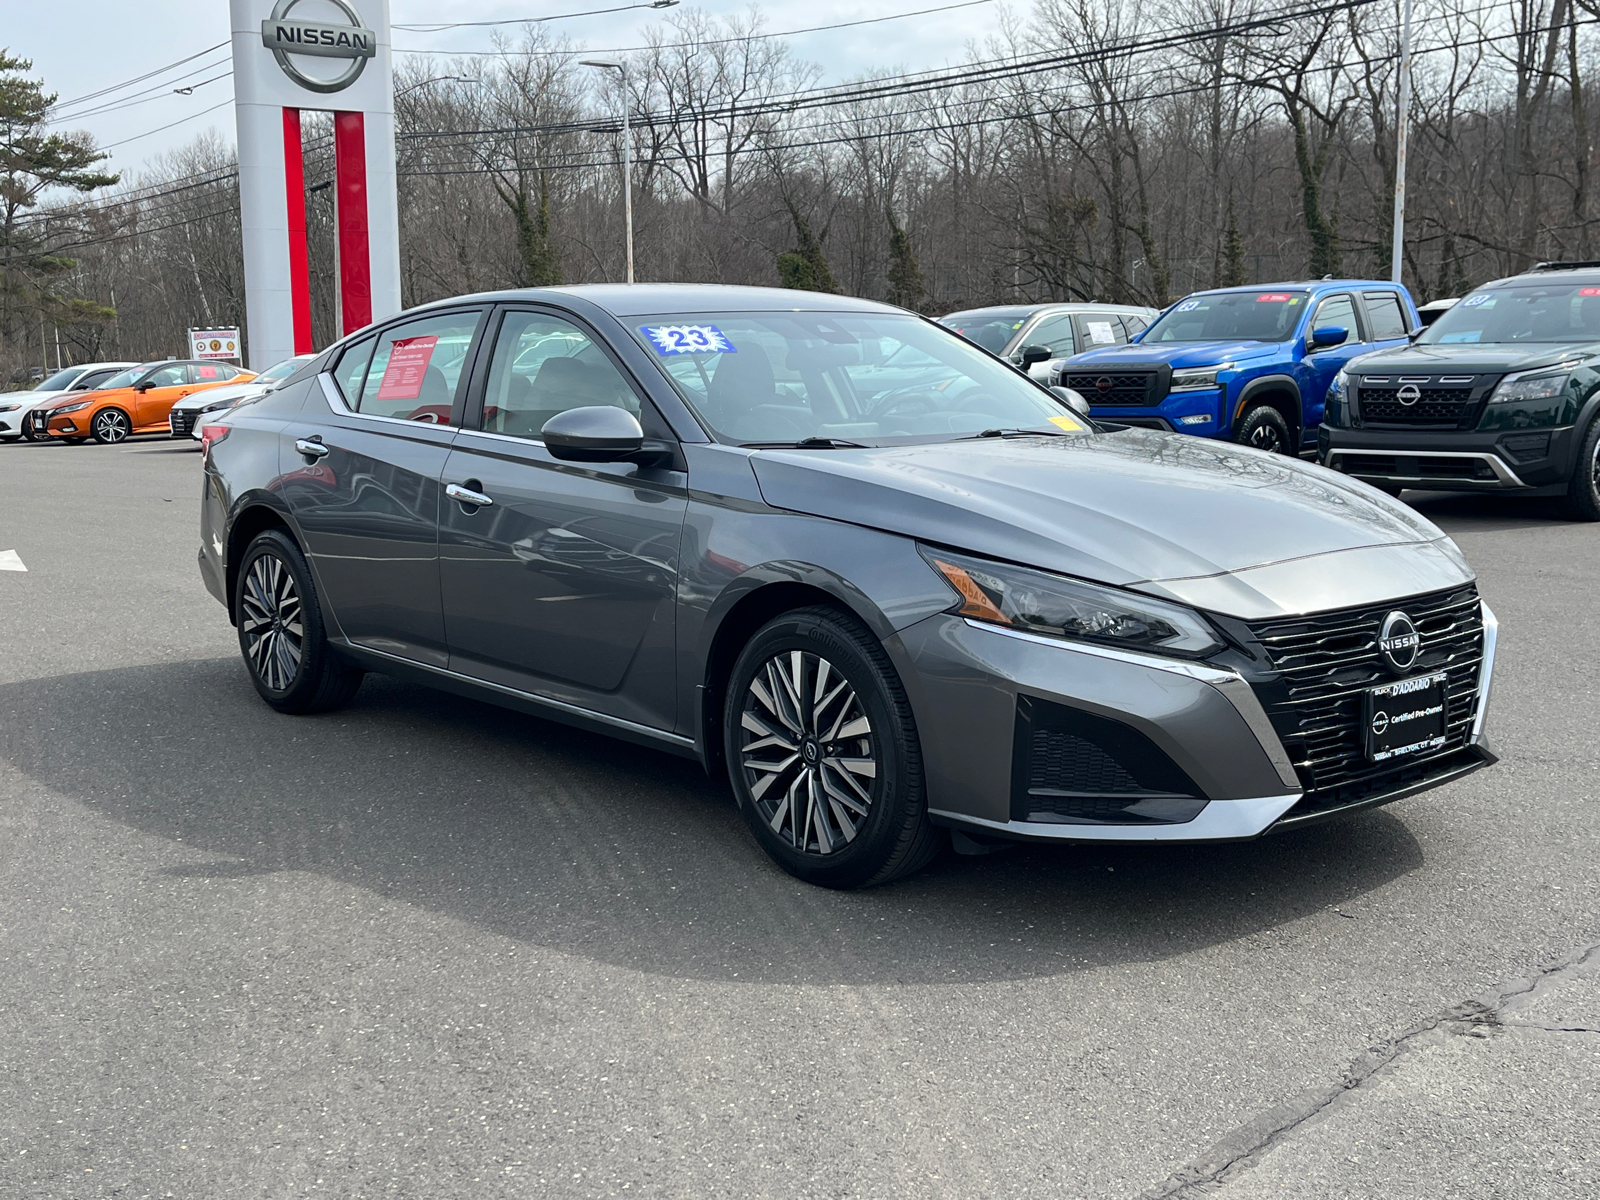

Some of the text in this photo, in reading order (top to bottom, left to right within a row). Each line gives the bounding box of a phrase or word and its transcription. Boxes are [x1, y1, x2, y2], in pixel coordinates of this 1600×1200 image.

[276, 26, 368, 50] NISSAN
[668, 329, 709, 347] 23
[1380, 634, 1420, 650] NISSAN
[1392, 678, 1430, 697] D'ADDARIO
[1391, 710, 1415, 724] Certified
[1415, 704, 1443, 719] Pre-Owned
